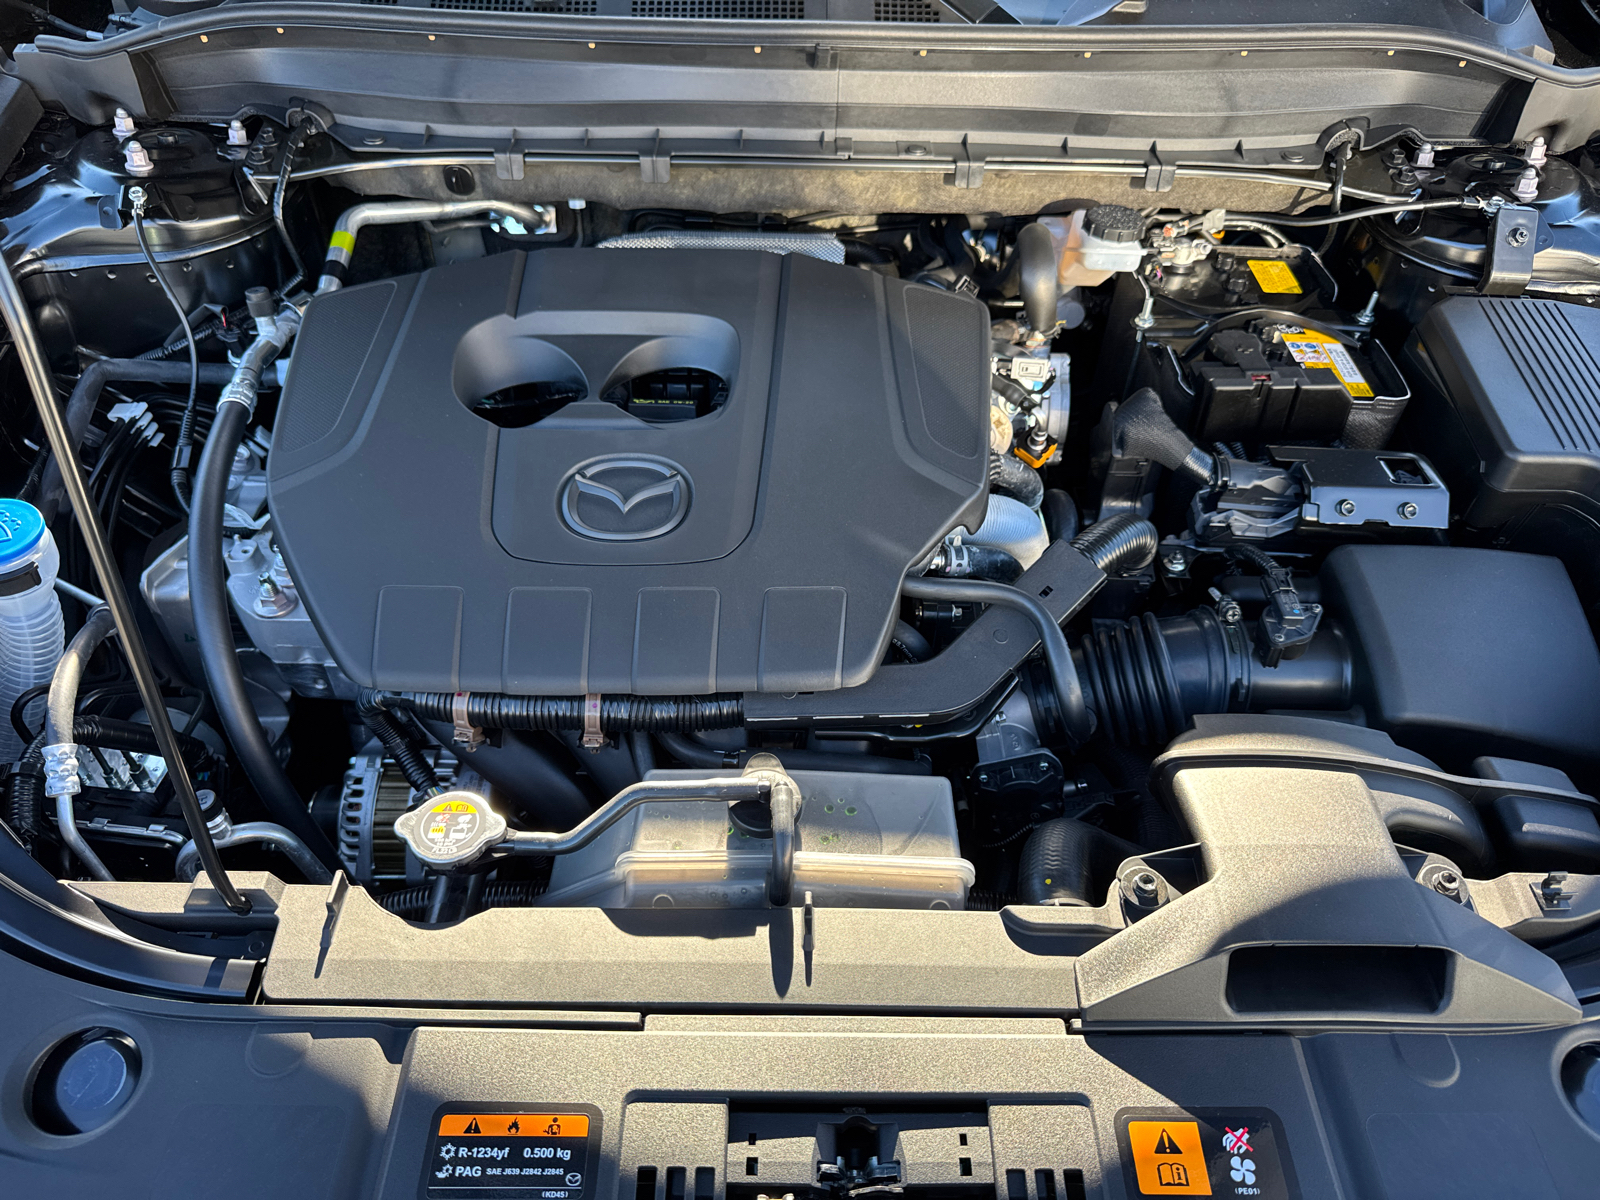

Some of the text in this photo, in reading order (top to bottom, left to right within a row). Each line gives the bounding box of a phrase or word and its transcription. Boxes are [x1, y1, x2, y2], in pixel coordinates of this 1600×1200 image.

[458, 1147, 571, 1160] R-1234yf 0.500 kg
[455, 1166, 482, 1177] PAG
